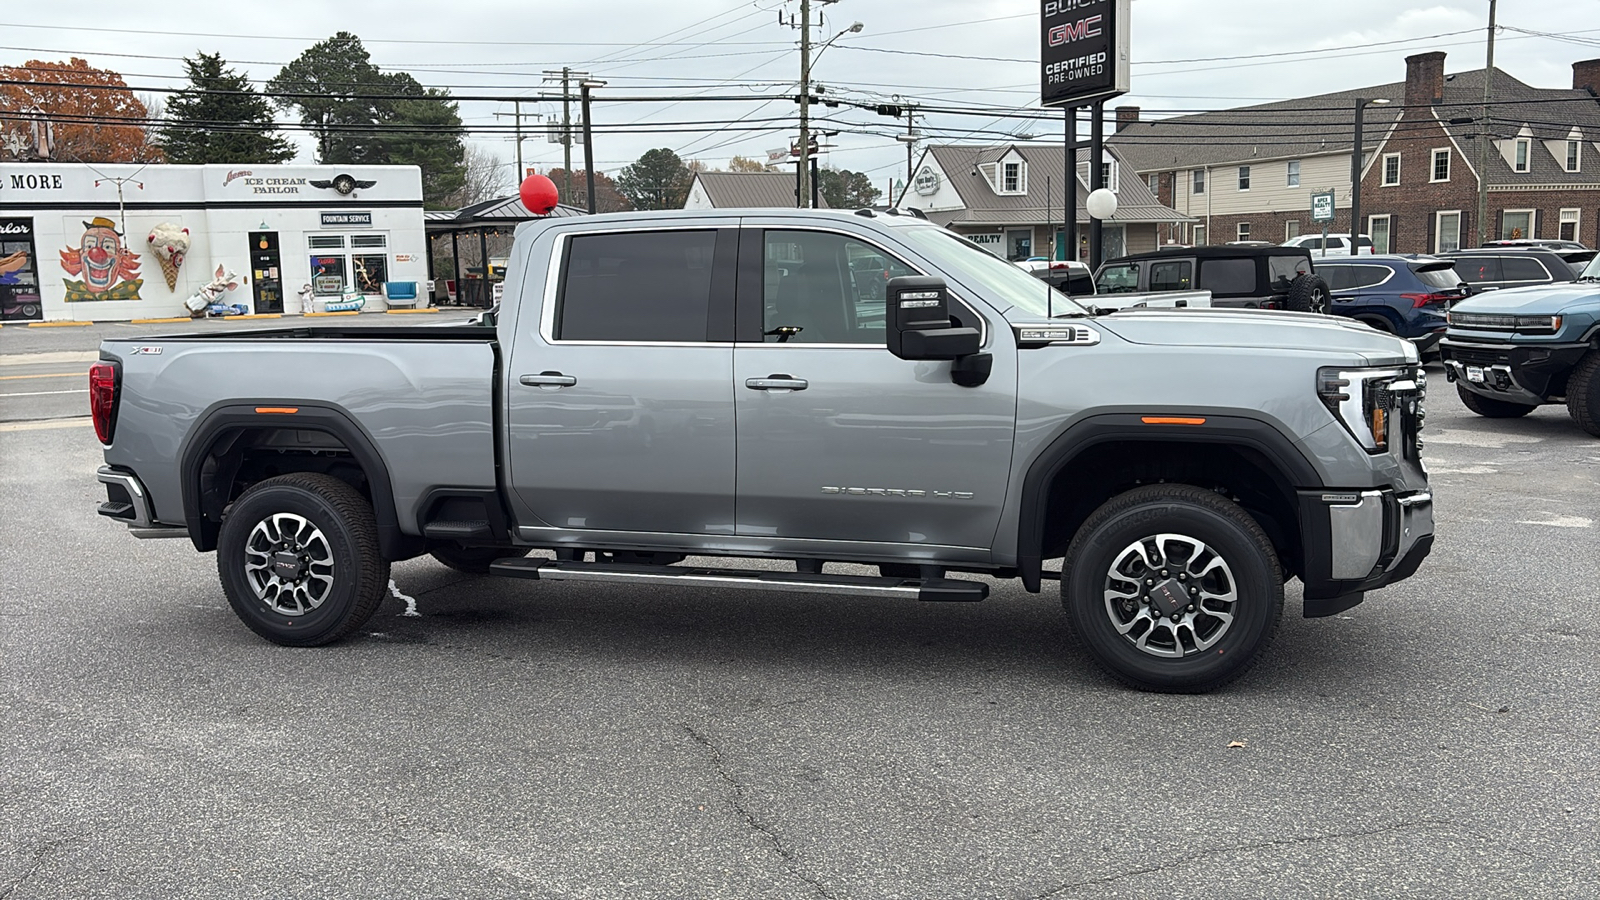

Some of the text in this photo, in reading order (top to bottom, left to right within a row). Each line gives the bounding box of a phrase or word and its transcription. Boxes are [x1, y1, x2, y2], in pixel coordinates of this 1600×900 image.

[1045, 0, 1105, 17] BUIC
[1049, 14, 1102, 47] GMC
[1045, 51, 1106, 75] CERTIFIED
[1048, 64, 1103, 85] PRE-OWNED
[10, 174, 63, 189] MORE
[244, 178, 307, 186] ICE CREAM
[253, 186, 299, 194] PARLOR
[322, 214, 370, 223] FOUNTAIN SERVICE
